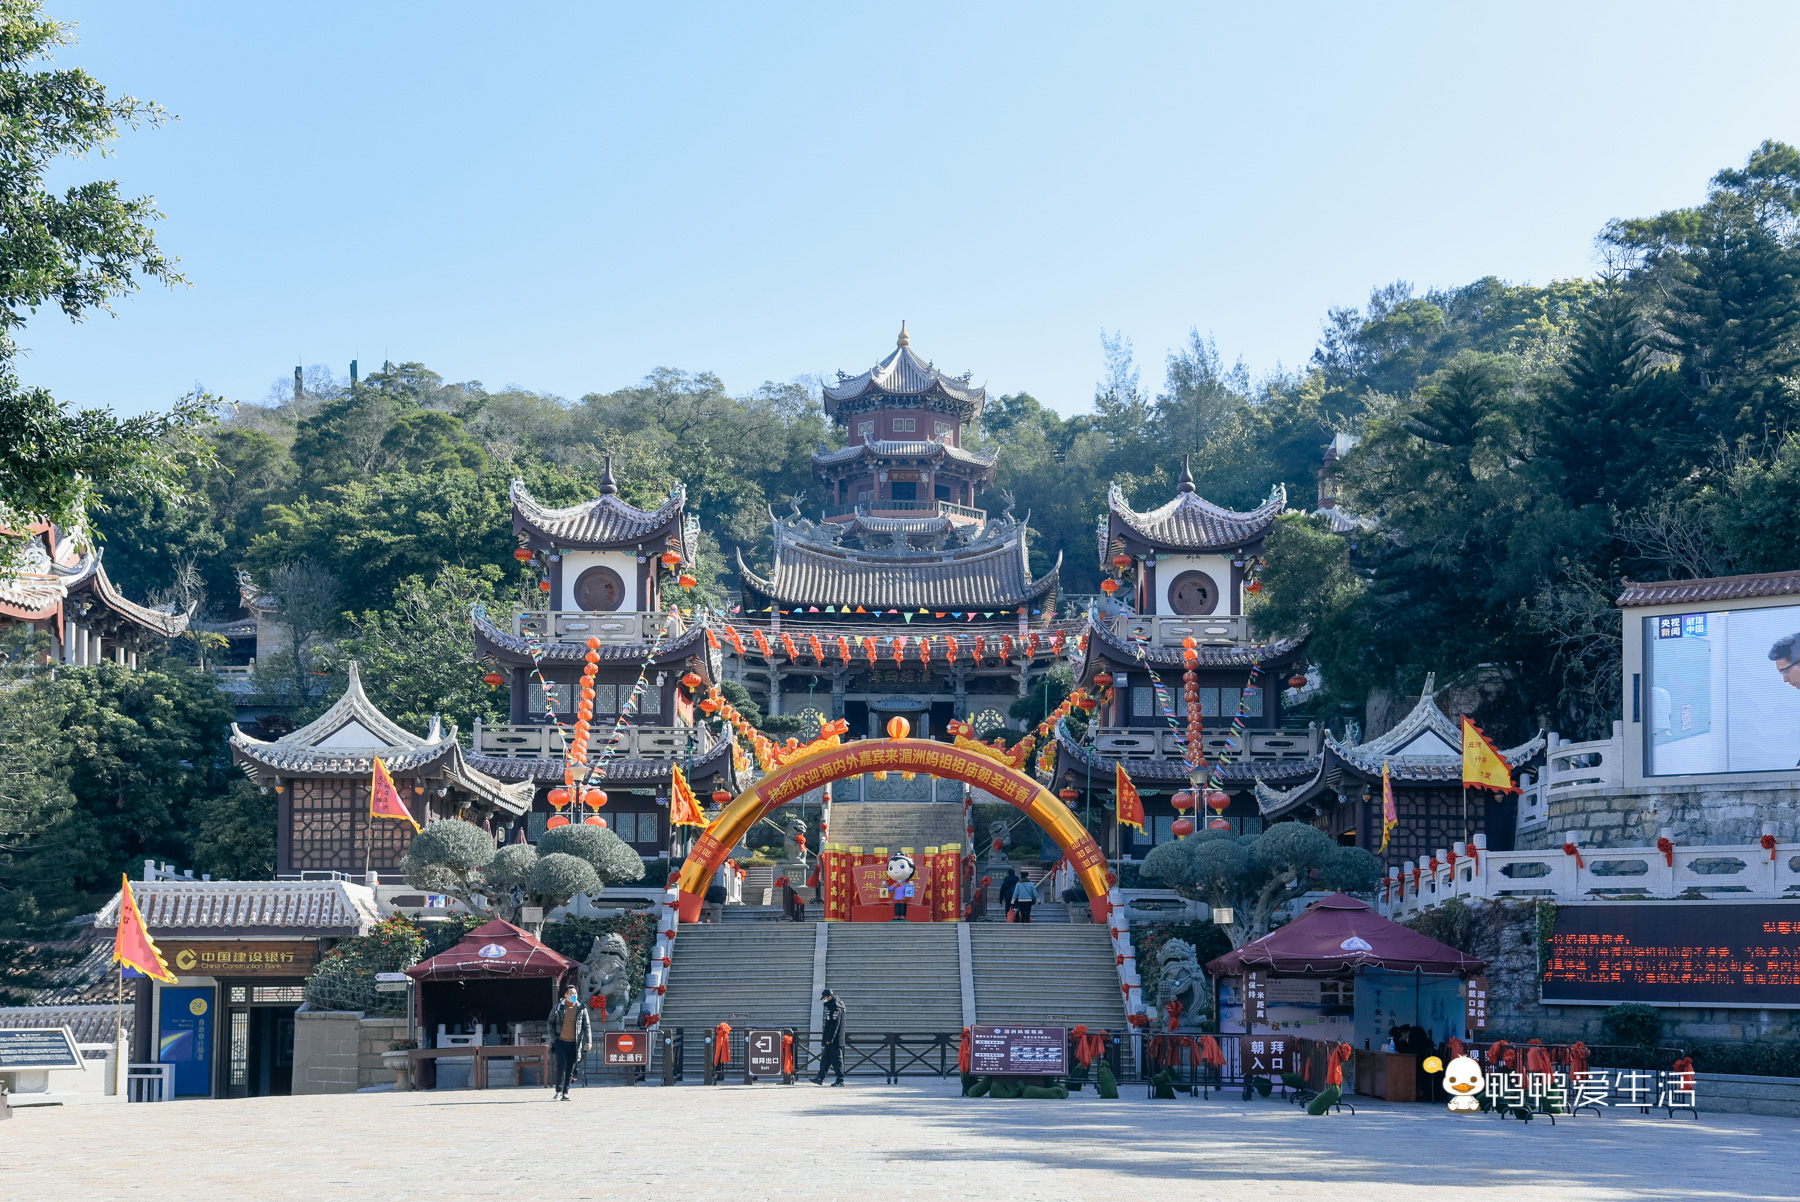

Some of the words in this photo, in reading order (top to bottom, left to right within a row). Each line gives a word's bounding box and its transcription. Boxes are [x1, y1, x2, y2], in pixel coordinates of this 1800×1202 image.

[1661, 617, 1680, 628] 央视
[1686, 616, 1704, 626] 健康
[1661, 627, 1680, 637] 新闻
[1686, 624, 1704, 633] 中国
[767, 748, 1031, 804] 热烈欢迎海内外嘉宾来湄洲妈祖祖庙朝圣进香
[830, 857, 838, 911] 福星高照
[947, 856, 955, 912] 吉祥如意
[201, 951, 294, 963] 中国建设银行
[1248, 972, 1256, 999] 请保持
[191, 1001, 202, 1009] 24
[1256, 983, 1265, 1018] 一米距离
[1468, 980, 1476, 1017] 佩戴口罩
[1477, 990, 1486, 1027] 测量体温
[1251, 1040, 1284, 1055] 朝拜
[609, 1053, 643, 1062] 禁止通行
[751, 1057, 779, 1065] 朝拜出口
[1251, 1057, 1283, 1070] 入口
